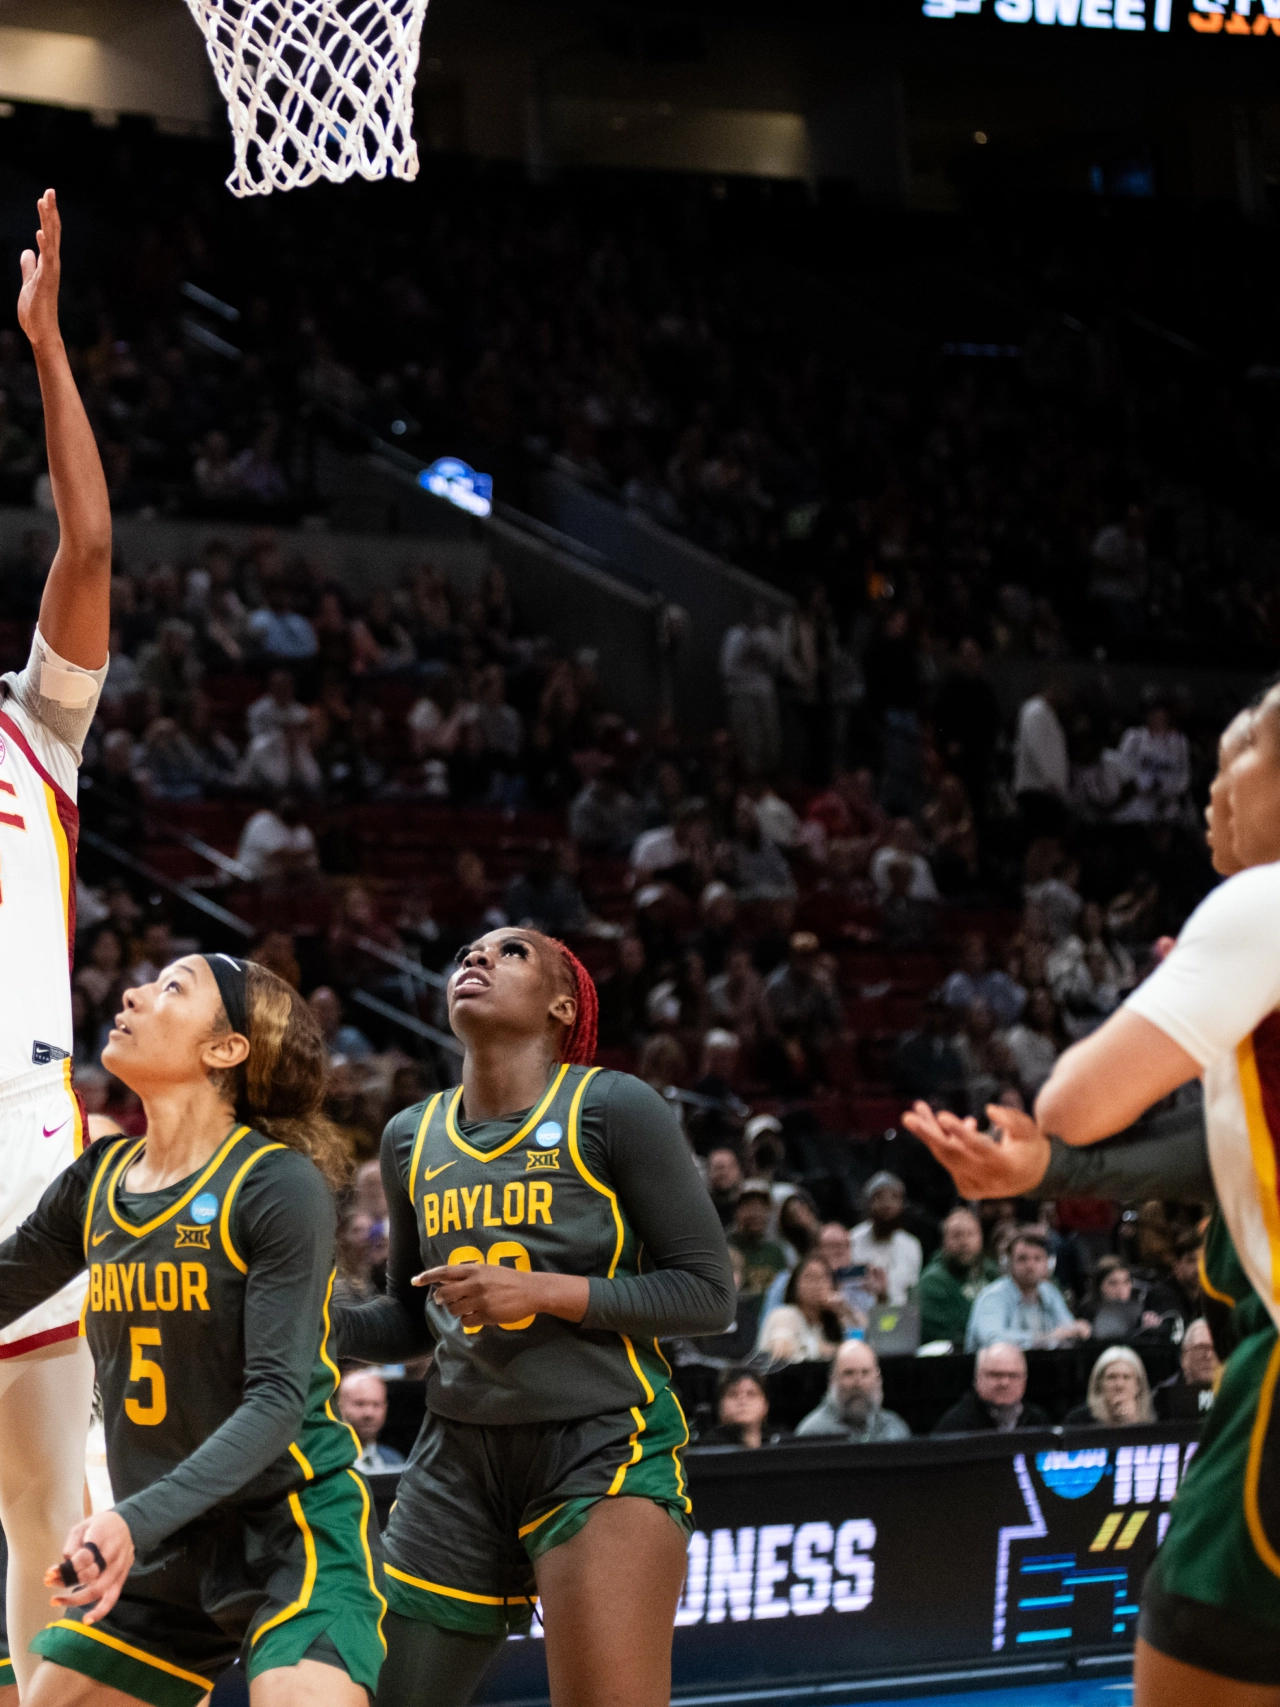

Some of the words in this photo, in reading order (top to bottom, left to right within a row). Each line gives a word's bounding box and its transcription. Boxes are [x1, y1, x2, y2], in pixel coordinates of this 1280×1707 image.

[423, 1181, 553, 1238] BAYLOR
[90, 1262, 211, 1312] BAYLOR
[124, 1326, 168, 1426] 5
